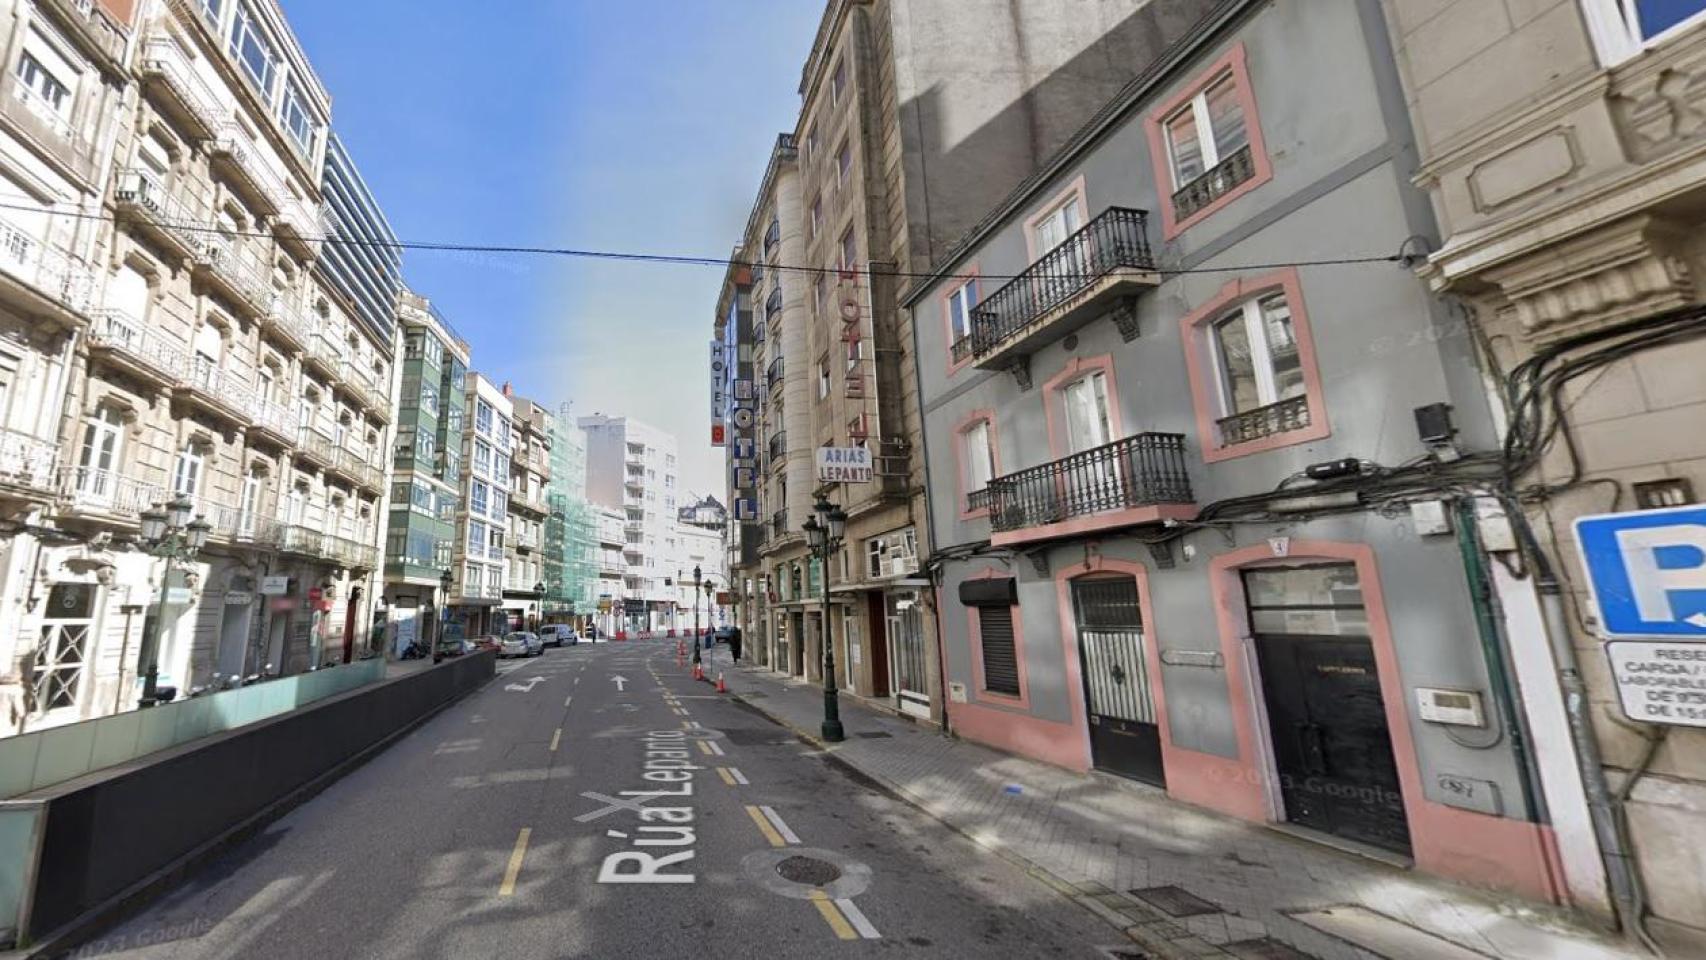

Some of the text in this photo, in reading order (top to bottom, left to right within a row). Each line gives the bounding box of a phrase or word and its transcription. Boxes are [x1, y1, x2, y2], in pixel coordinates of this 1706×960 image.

[838, 261, 867, 437] HOTEL
[712, 346, 723, 418] HOTEL
[734, 380, 755, 519] HOTEL
[825, 450, 865, 464] ARIAS
[821, 466, 872, 480] LEPANTO
[1614, 524, 1706, 622] P
[1625, 661, 1690, 675] CARGA
[1646, 690, 1675, 702] DE
[1646, 704, 1674, 717] DE
